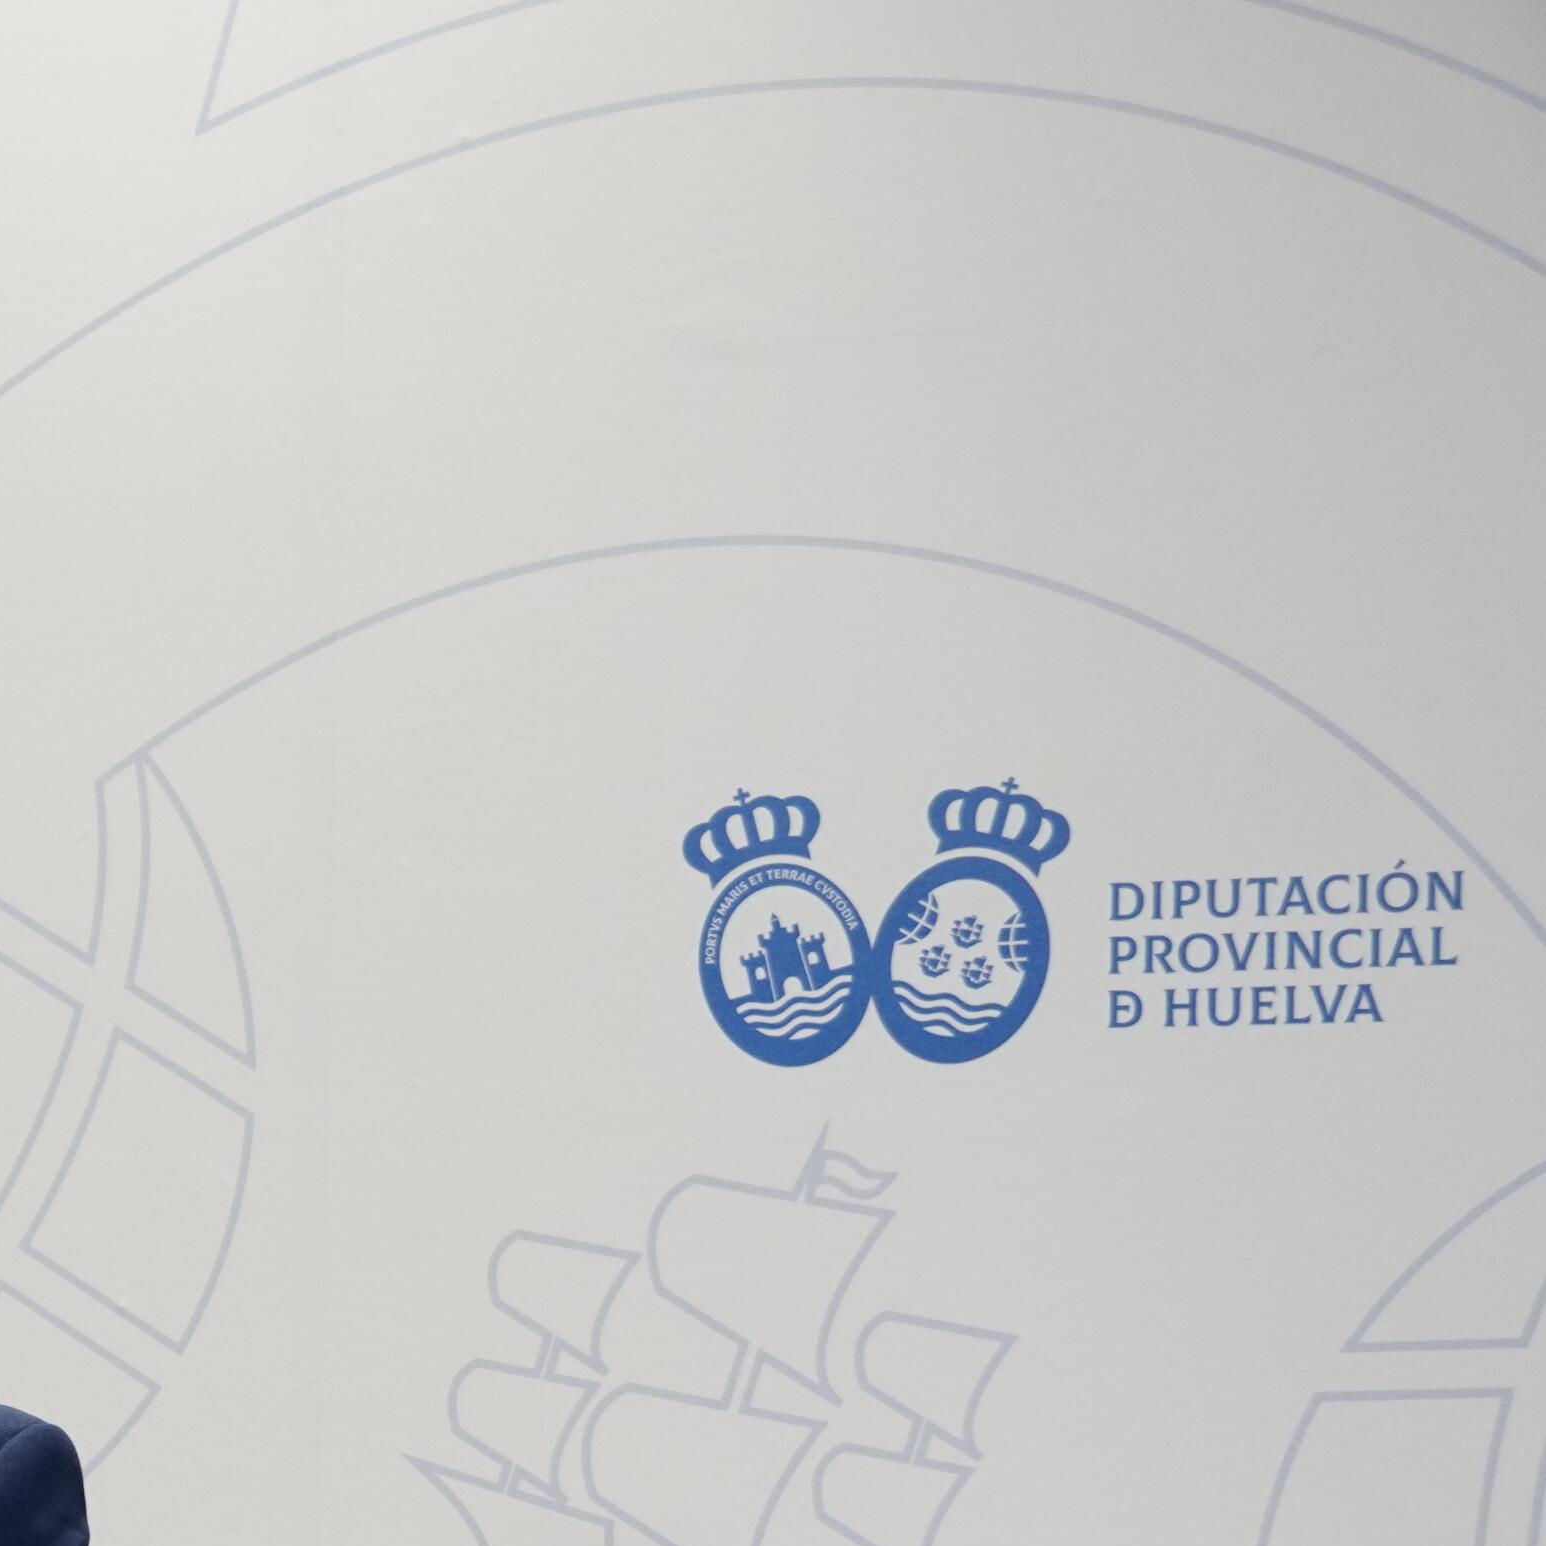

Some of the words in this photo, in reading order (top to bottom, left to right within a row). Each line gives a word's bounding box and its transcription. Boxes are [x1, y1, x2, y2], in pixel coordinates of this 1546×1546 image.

[705, 918, 723, 965] PORTVS
[717, 880, 749, 917] MARIS
[748, 873, 765, 886] ET
[766, 868, 816, 886] TERRAE
[813, 880, 859, 931] CVSTODIA
[1108, 858, 1465, 921] DIPUTACIÓN
[1108, 926, 1460, 975] PROVINCIAL
[1163, 983, 1385, 1028] HUELVA
